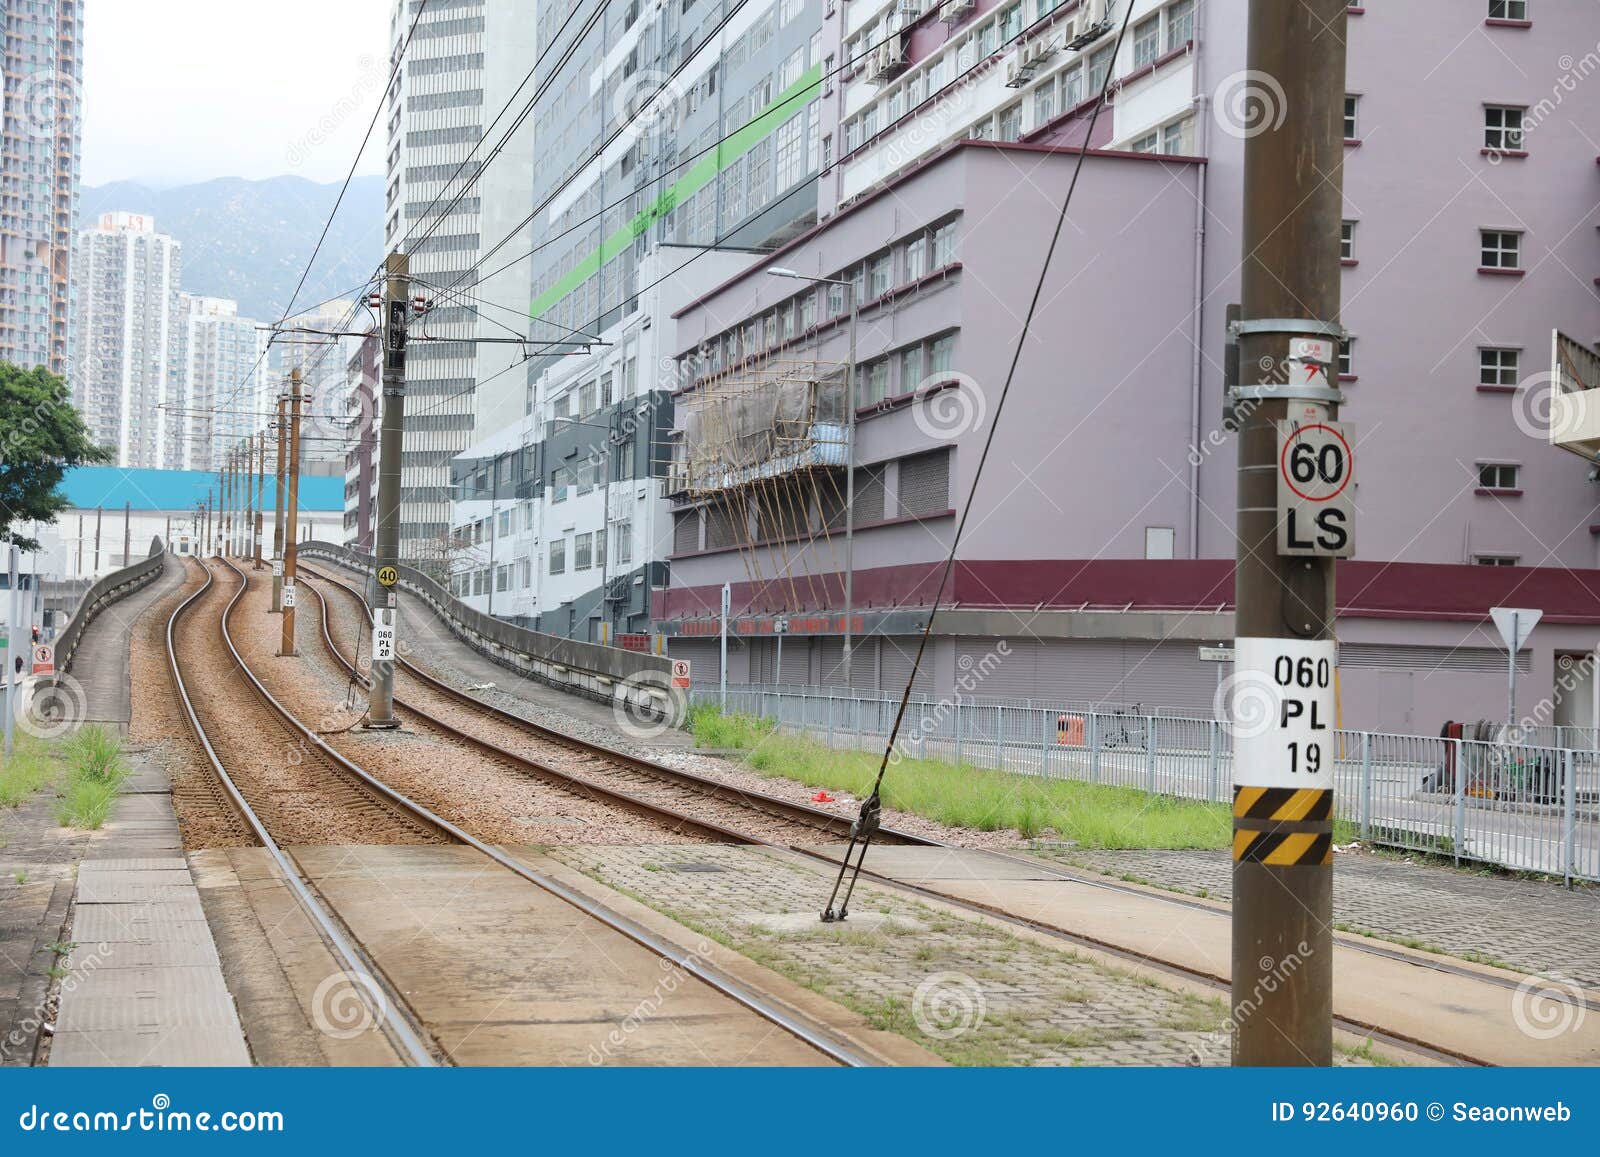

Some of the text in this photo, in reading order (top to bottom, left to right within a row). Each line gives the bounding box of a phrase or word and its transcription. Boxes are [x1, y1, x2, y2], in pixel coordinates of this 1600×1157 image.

[1291, 443, 1344, 484] 60
[1287, 508, 1347, 550] LS
[380, 570, 396, 582] 40
[378, 630, 393, 639] 060
[379, 640, 391, 648] PL
[379, 649, 390, 657] 20
[1274, 655, 1330, 689] 060
[1280, 699, 1327, 730] PL
[1287, 742, 1321, 774] 19
